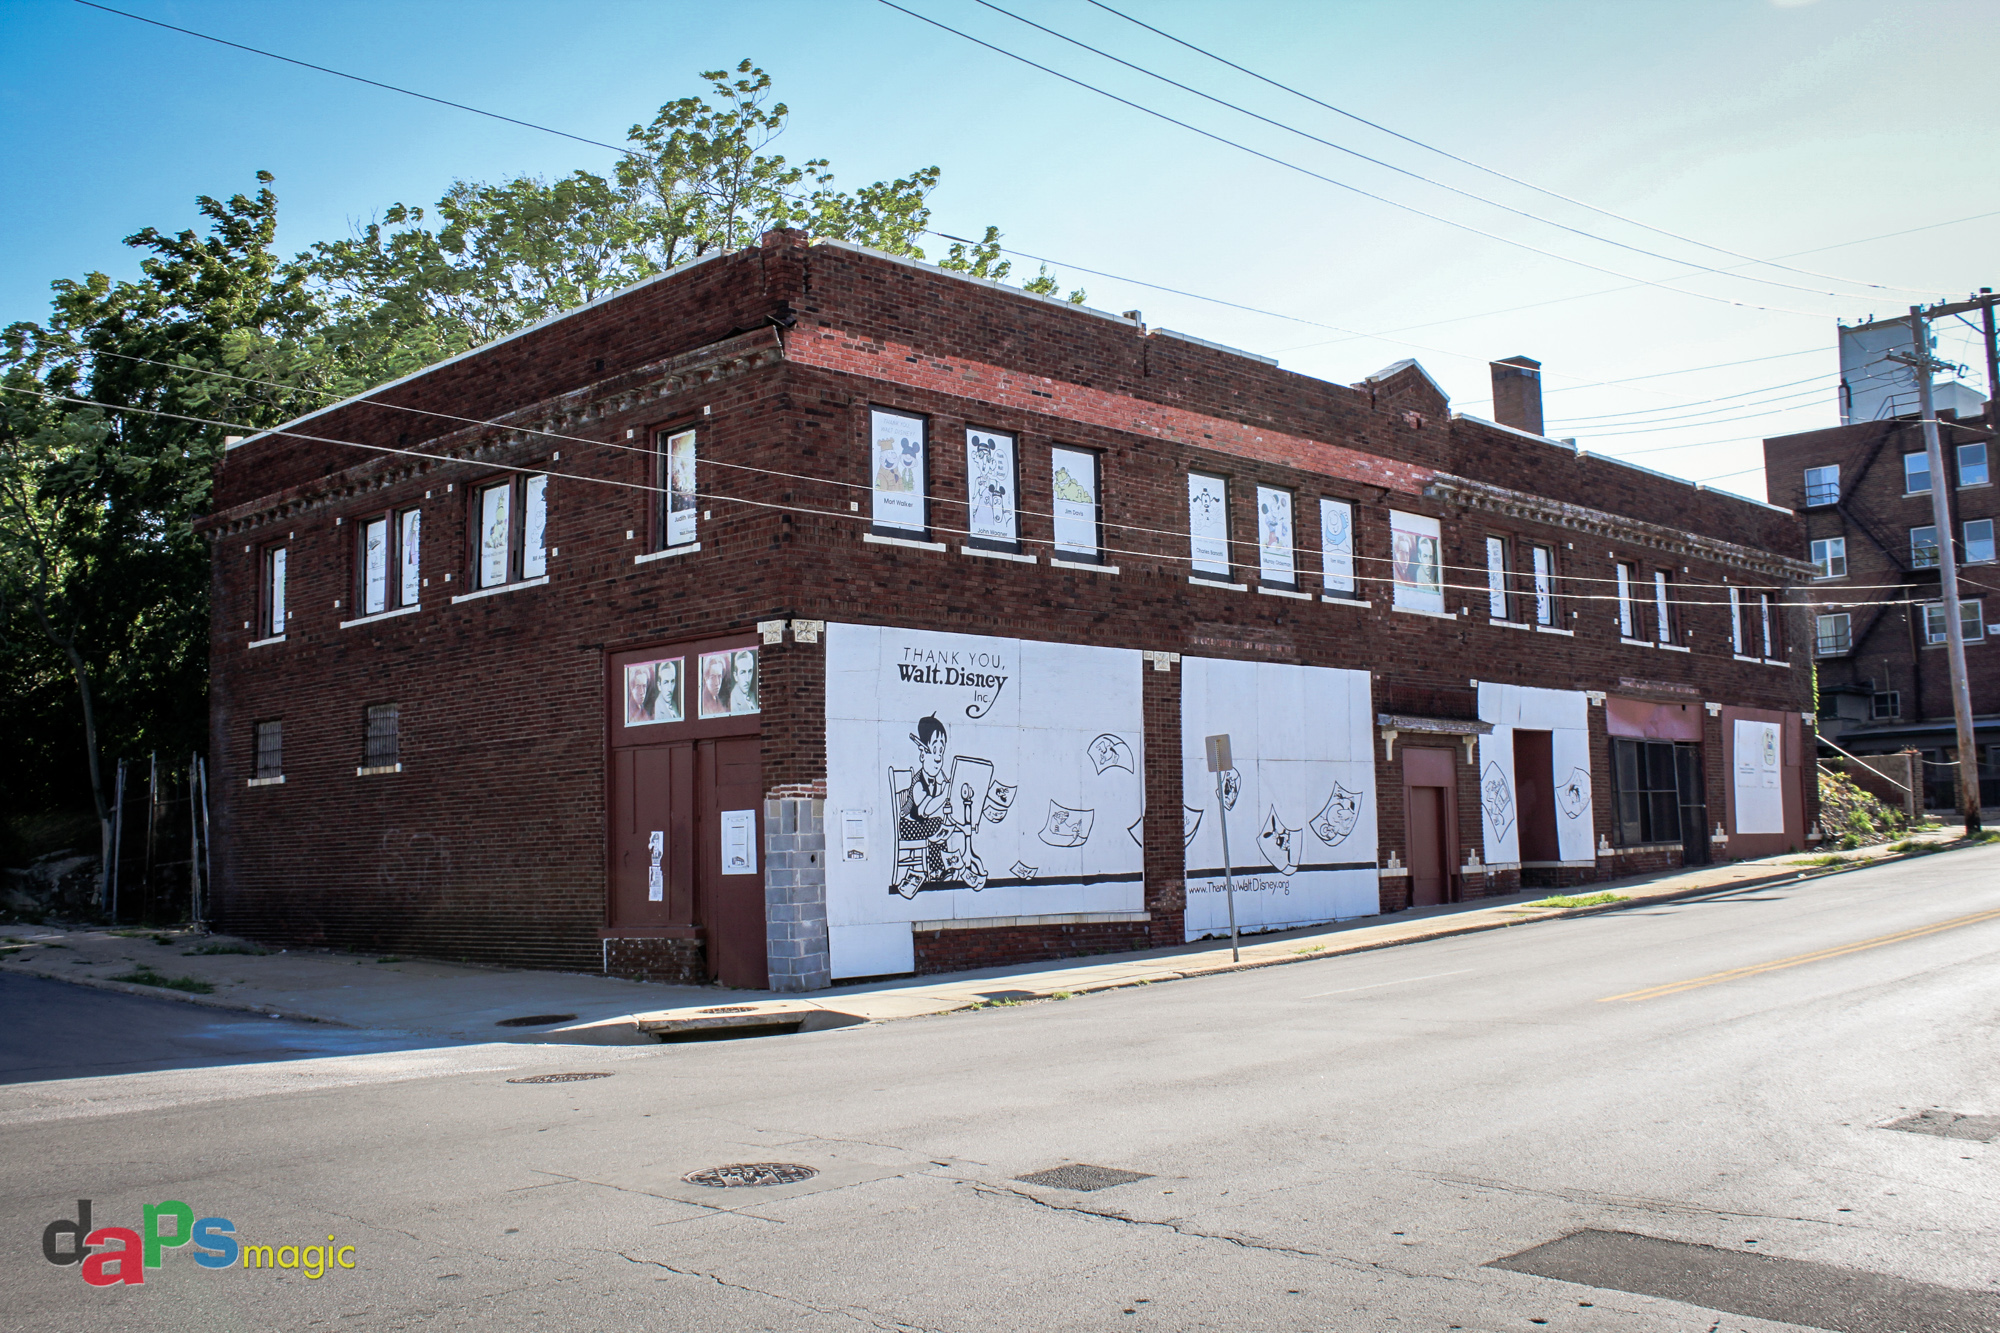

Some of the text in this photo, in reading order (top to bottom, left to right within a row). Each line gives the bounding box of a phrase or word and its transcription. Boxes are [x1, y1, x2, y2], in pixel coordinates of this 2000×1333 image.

[896, 500, 914, 508] Walker
[903, 647, 1006, 671] THANK YOU,
[974, 690, 991, 703] Inc.
[1189, 878, 1290, 896] www.ThankouWaltDisney.org
